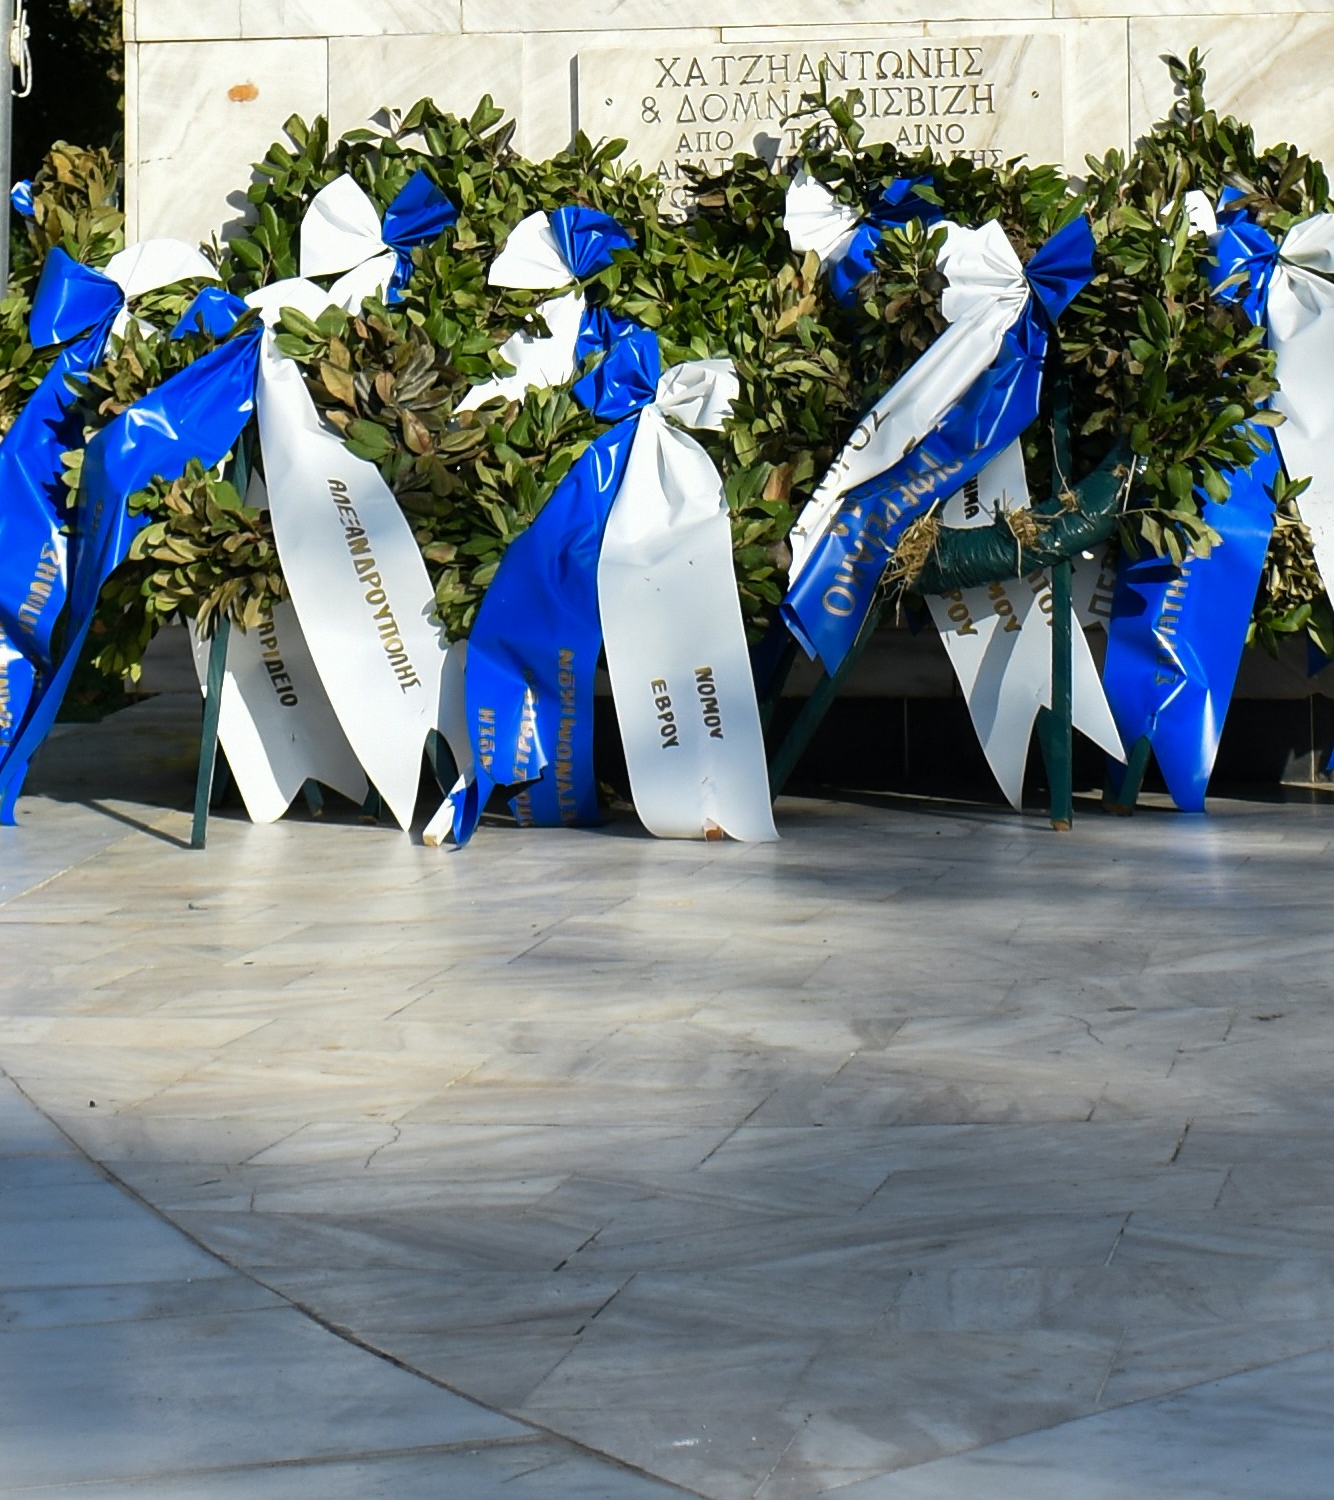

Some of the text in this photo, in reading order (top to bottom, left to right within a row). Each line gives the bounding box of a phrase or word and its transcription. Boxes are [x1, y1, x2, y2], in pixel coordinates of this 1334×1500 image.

[655, 47, 984, 88] ΧΑΤΖΗΑΝΤΩΝΗΣ
[641, 96, 662, 123] &
[676, 131, 734, 154] ΑΠΟ
[896, 123, 965, 147] ΑΙΝΟ
[650, 678, 680, 749] ΕΒΡΟΥ
[694, 666, 724, 740] ΝΟΜΟΥ
